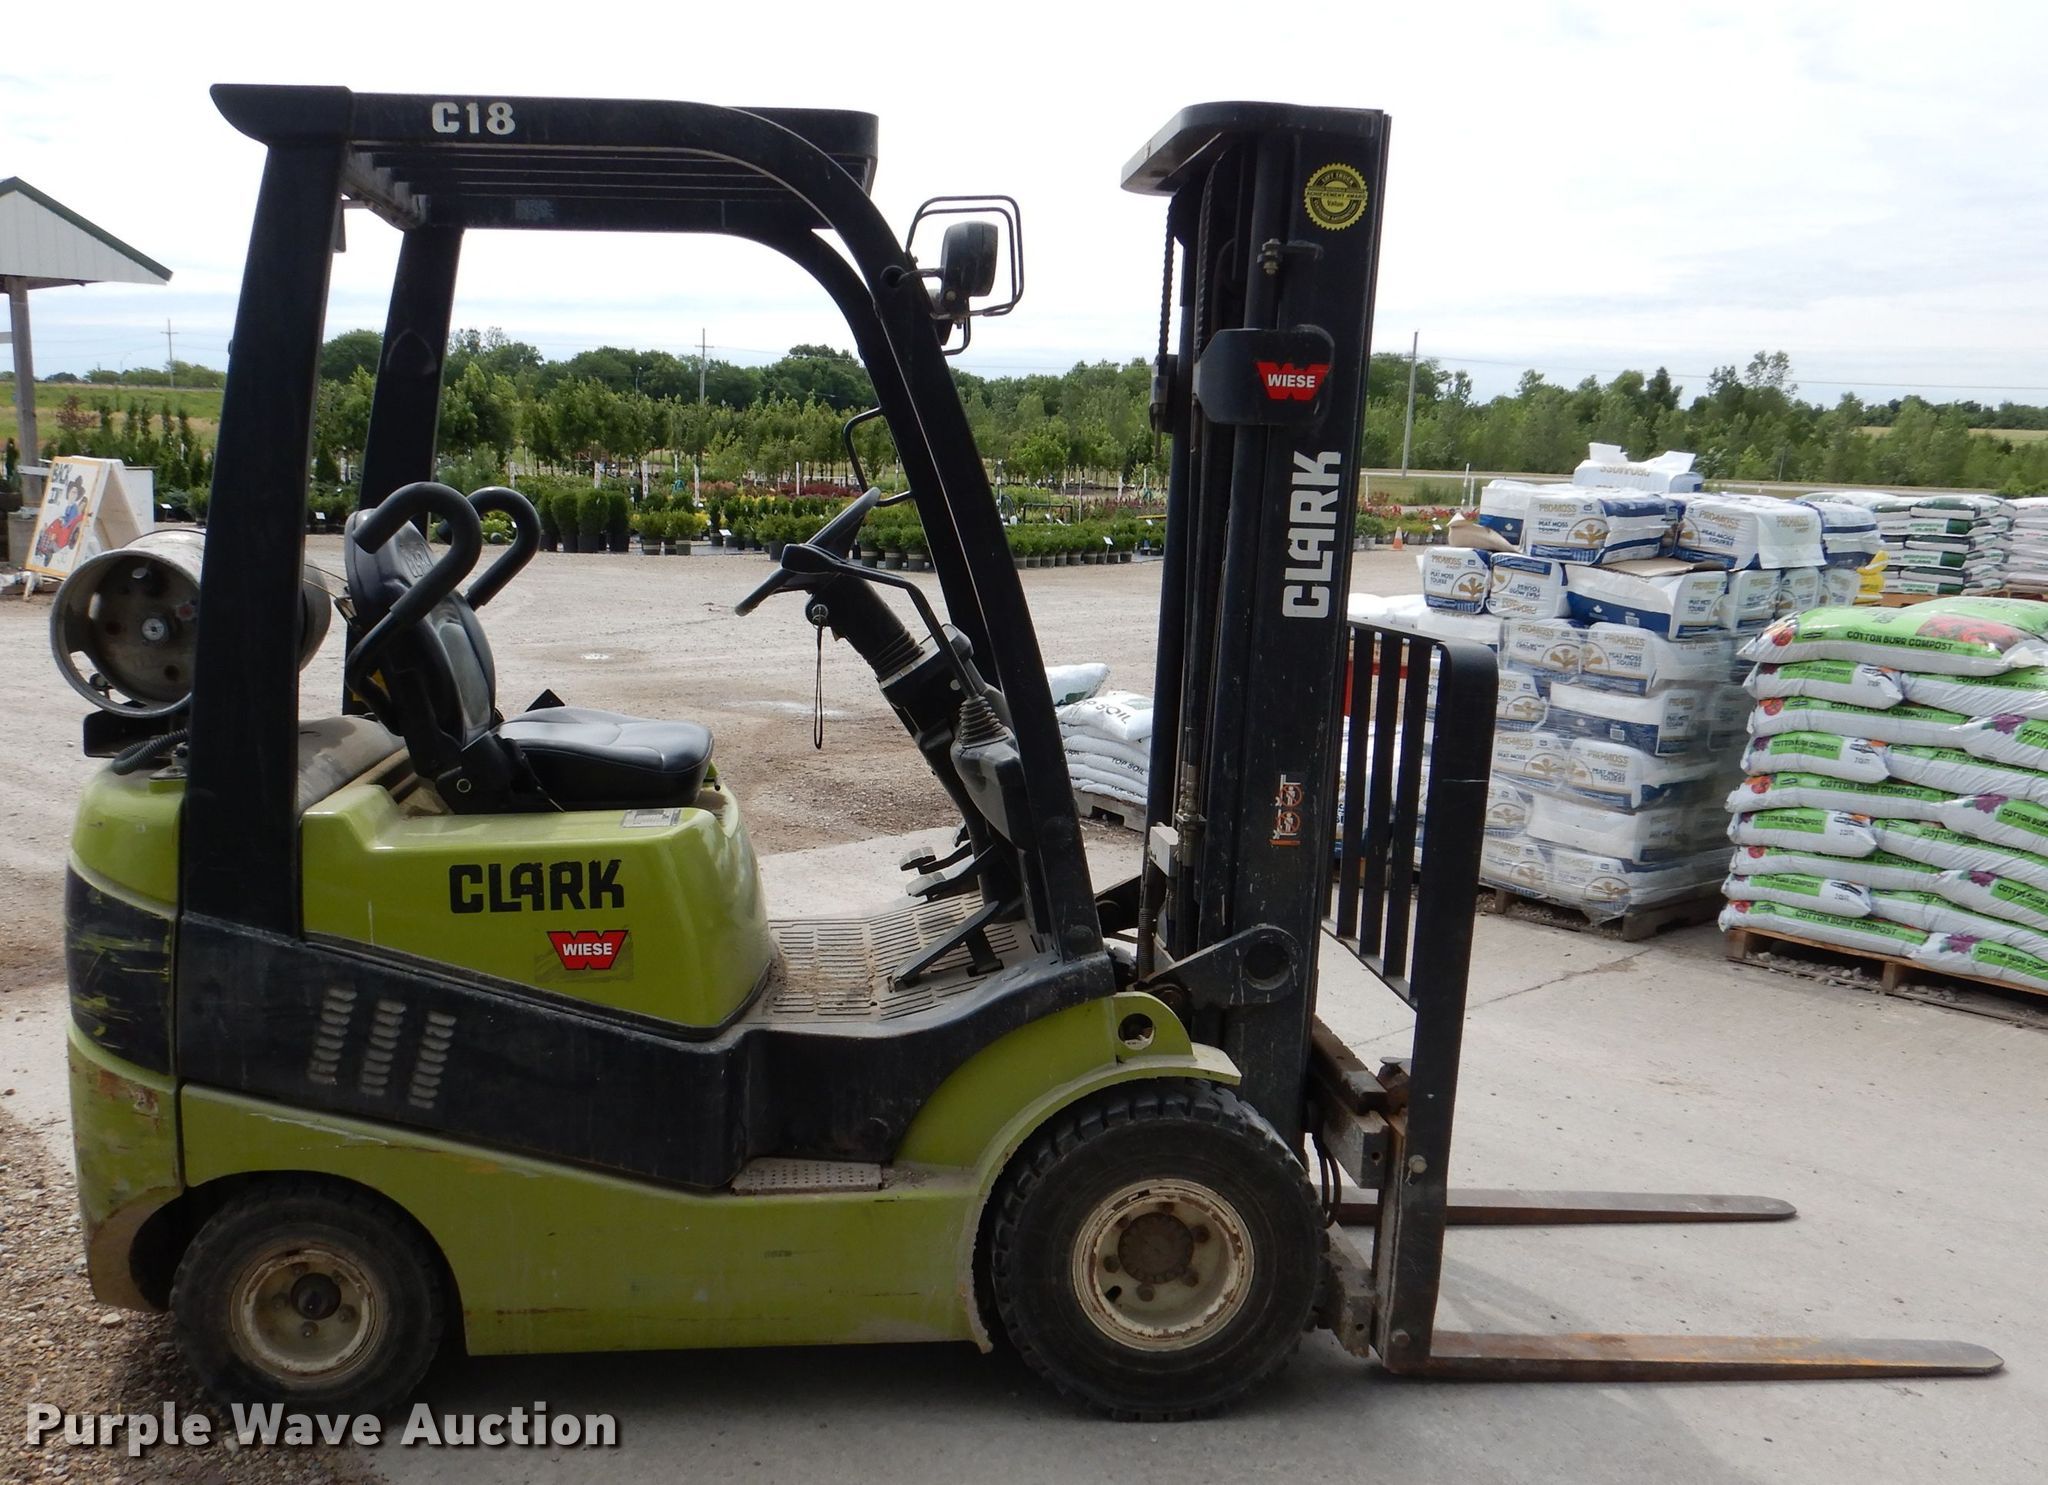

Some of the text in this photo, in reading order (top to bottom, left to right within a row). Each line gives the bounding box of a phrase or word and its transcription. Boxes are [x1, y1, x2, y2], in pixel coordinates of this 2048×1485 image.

[431, 101, 517, 136] C18
[1267, 373, 1316, 389] WIESE
[1281, 450, 1342, 619] CLARK
[1846, 630, 1954, 650] COTTON BURR COMPOST
[1623, 653, 1643, 663] MOSS
[1096, 703, 1131, 725] SOIL
[1809, 741, 1839, 752] COMPOST
[1112, 757, 1146, 776] TOP SOIL
[1819, 779, 1856, 791] COTTON
[1880, 785, 1922, 797] COMPOST
[2002, 808, 2031, 823] COTTON
[448, 858, 625, 915] CLARK
[1795, 909, 1830, 923] COTTON
[1854, 921, 1898, 936] COMPOST
[562, 942, 613, 957] WIESE
[1977, 947, 2007, 958] COTTON
